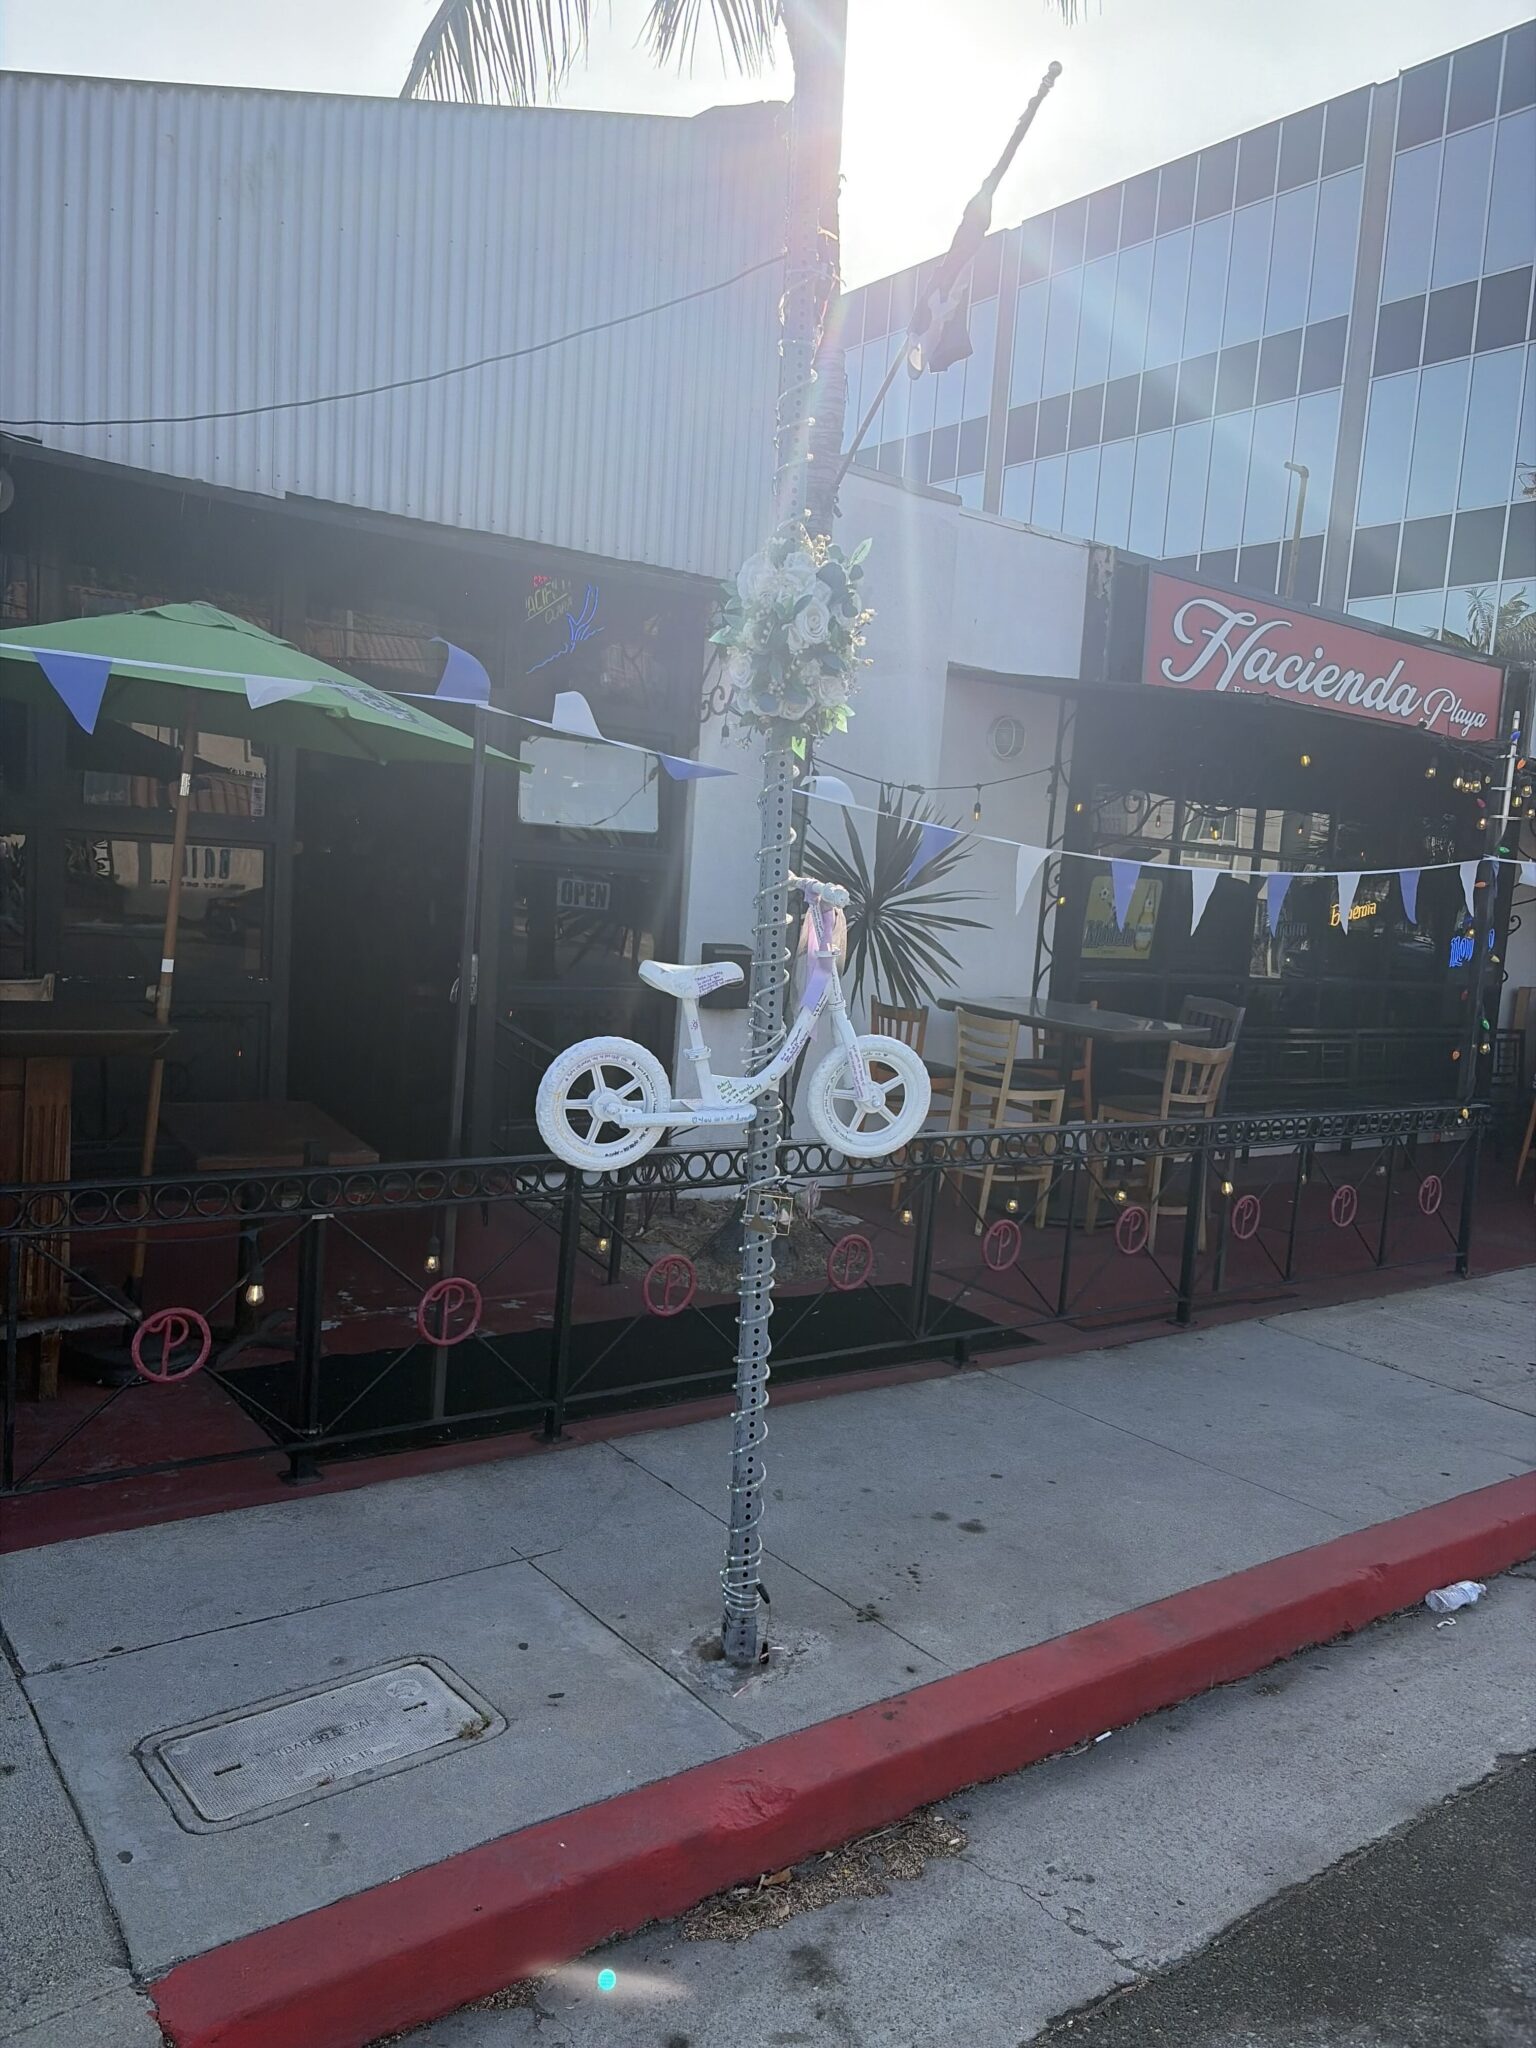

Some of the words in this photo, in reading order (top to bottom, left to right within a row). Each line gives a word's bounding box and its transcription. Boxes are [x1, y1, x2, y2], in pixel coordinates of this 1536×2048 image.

[1161, 598, 1421, 718] Hacienda
[1422, 687, 1488, 737] Playa
[561, 880, 608, 909] OPEN
[1329, 899, 1377, 927] Bemia
[274, 1731, 330, 1757] TRAFFIC
